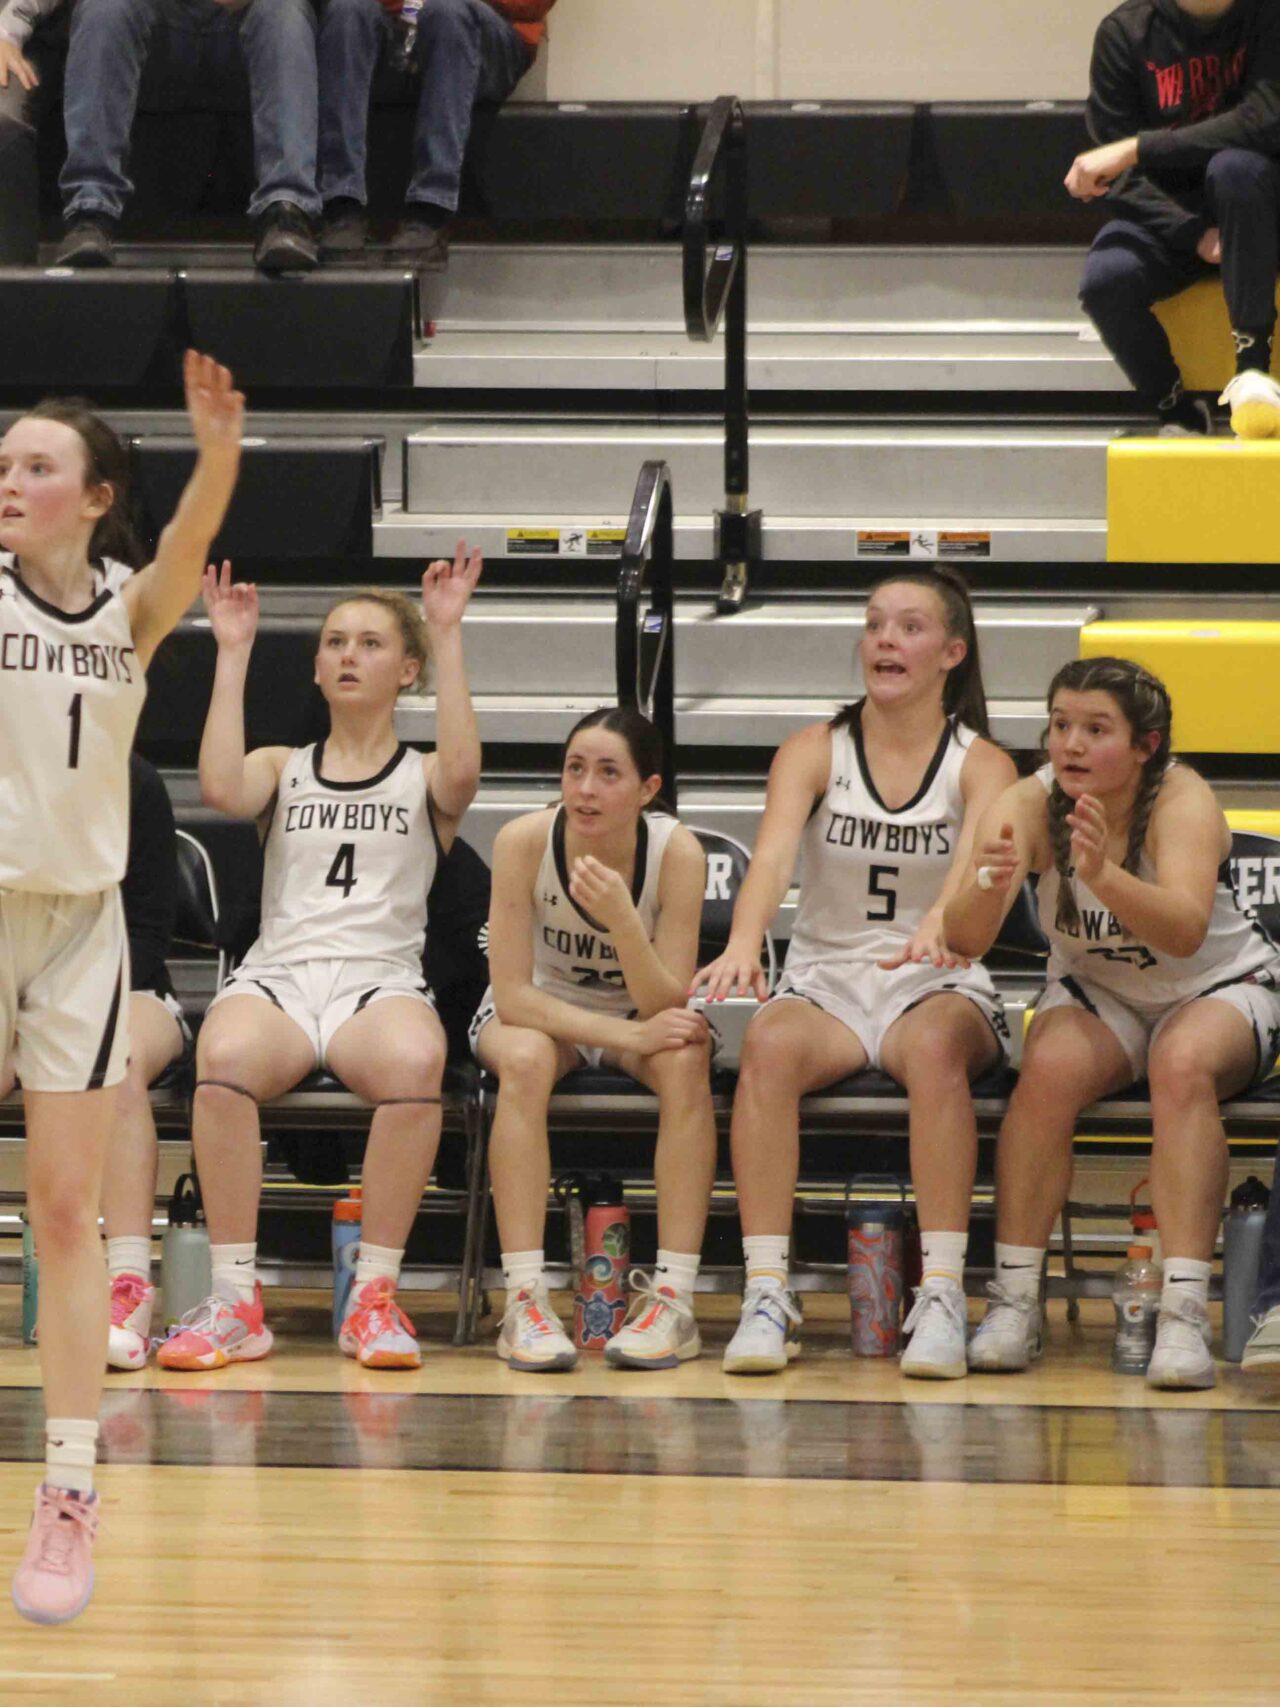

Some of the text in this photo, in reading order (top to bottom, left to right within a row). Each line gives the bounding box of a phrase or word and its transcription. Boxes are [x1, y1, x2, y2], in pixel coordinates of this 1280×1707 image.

[1, 633, 135, 684] COWBOYS
[67, 693, 82, 769] 1
[285, 803, 409, 836] COWBOYS
[825, 813, 950, 855] COWBOYS
[325, 843, 359, 899] 4
[866, 864, 899, 921] 5
